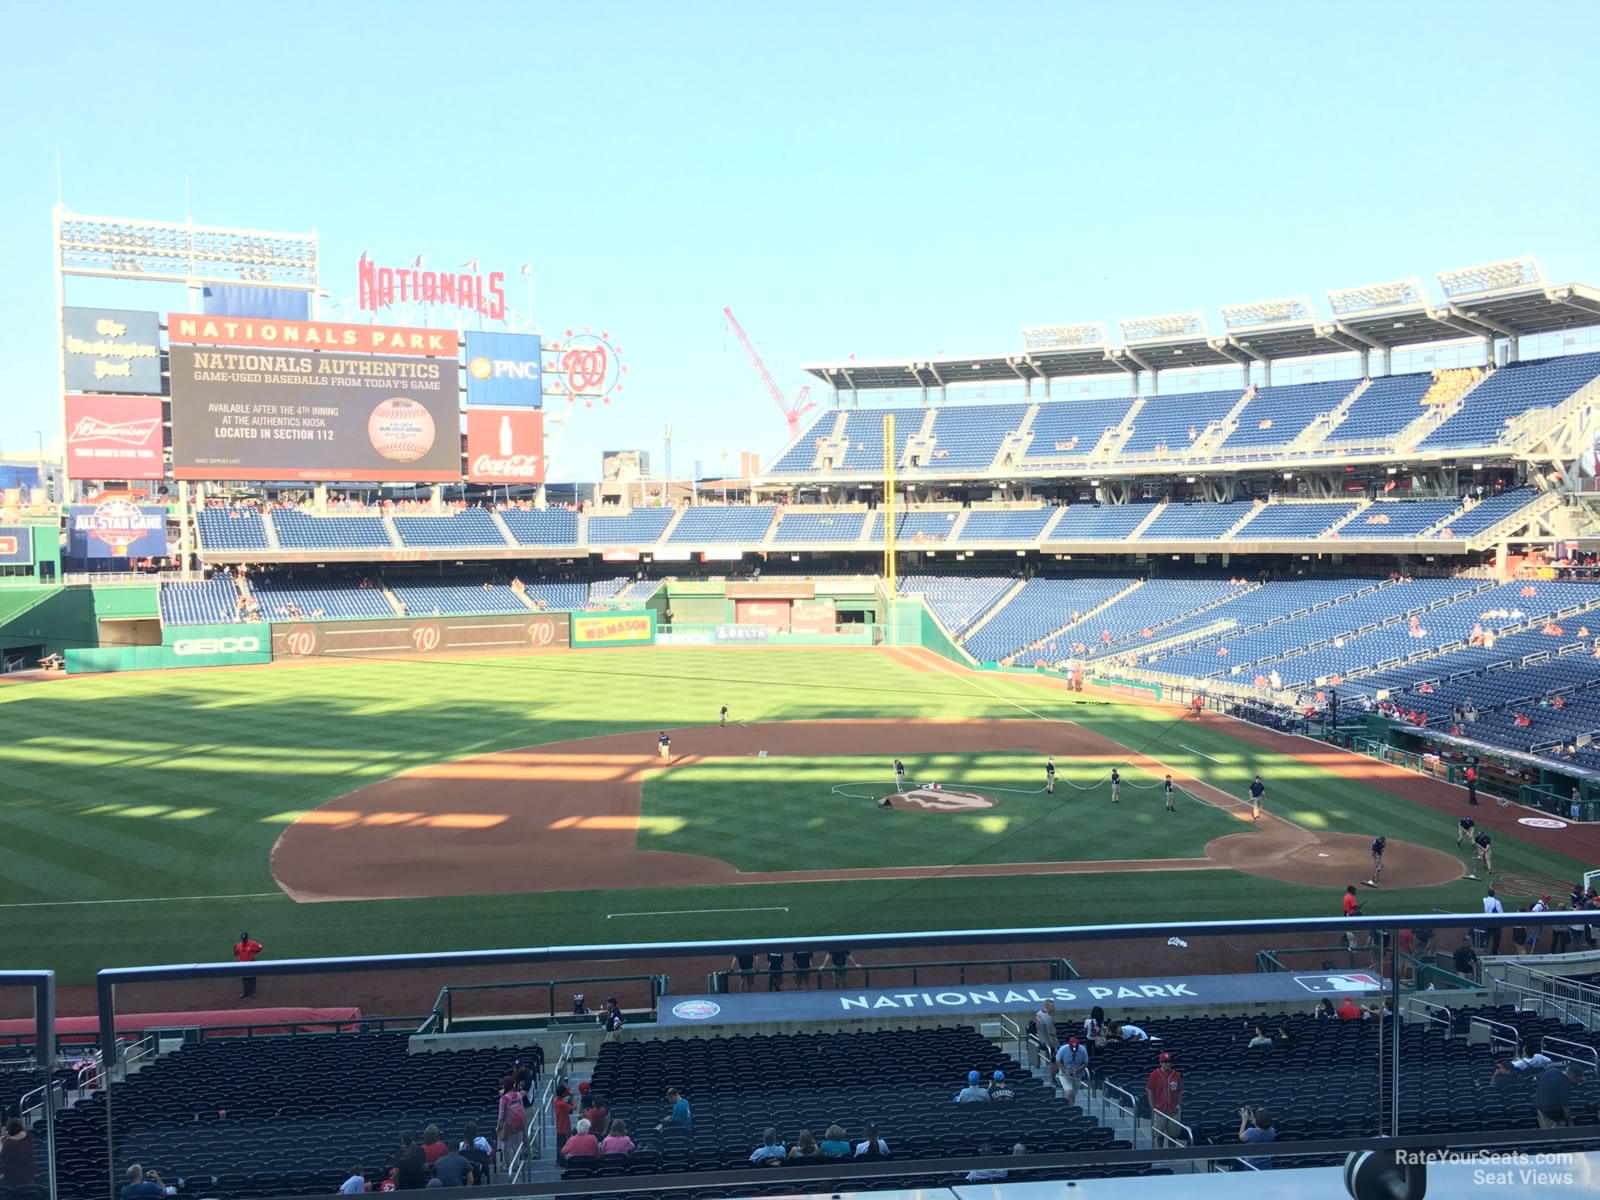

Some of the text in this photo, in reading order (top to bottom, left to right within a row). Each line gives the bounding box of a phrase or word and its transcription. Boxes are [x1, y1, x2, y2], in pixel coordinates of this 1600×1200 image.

[359, 260, 505, 320] NATIONALS
[180, 320, 443, 349] NATIONALS PARK
[193, 352, 440, 379] NATIONALS AUTHENTICS
[493, 360, 538, 379] PNC
[194, 371, 441, 390] GAME-USED BASEBALLS FROM TODAY'S GAME
[208, 403, 339, 417] AVAILABLE AFTER THE 4TH INNING
[222, 416, 326, 427] AT THE AUTHENTICS KIOSK
[215, 427, 334, 441] LOCATED IN SECTION 112
[130, 516, 162, 530] GAME
[729, 629, 766, 638] DELTA
[173, 636, 260, 655] GEICO
[839, 983, 1199, 1010] NATIONALS PARK
